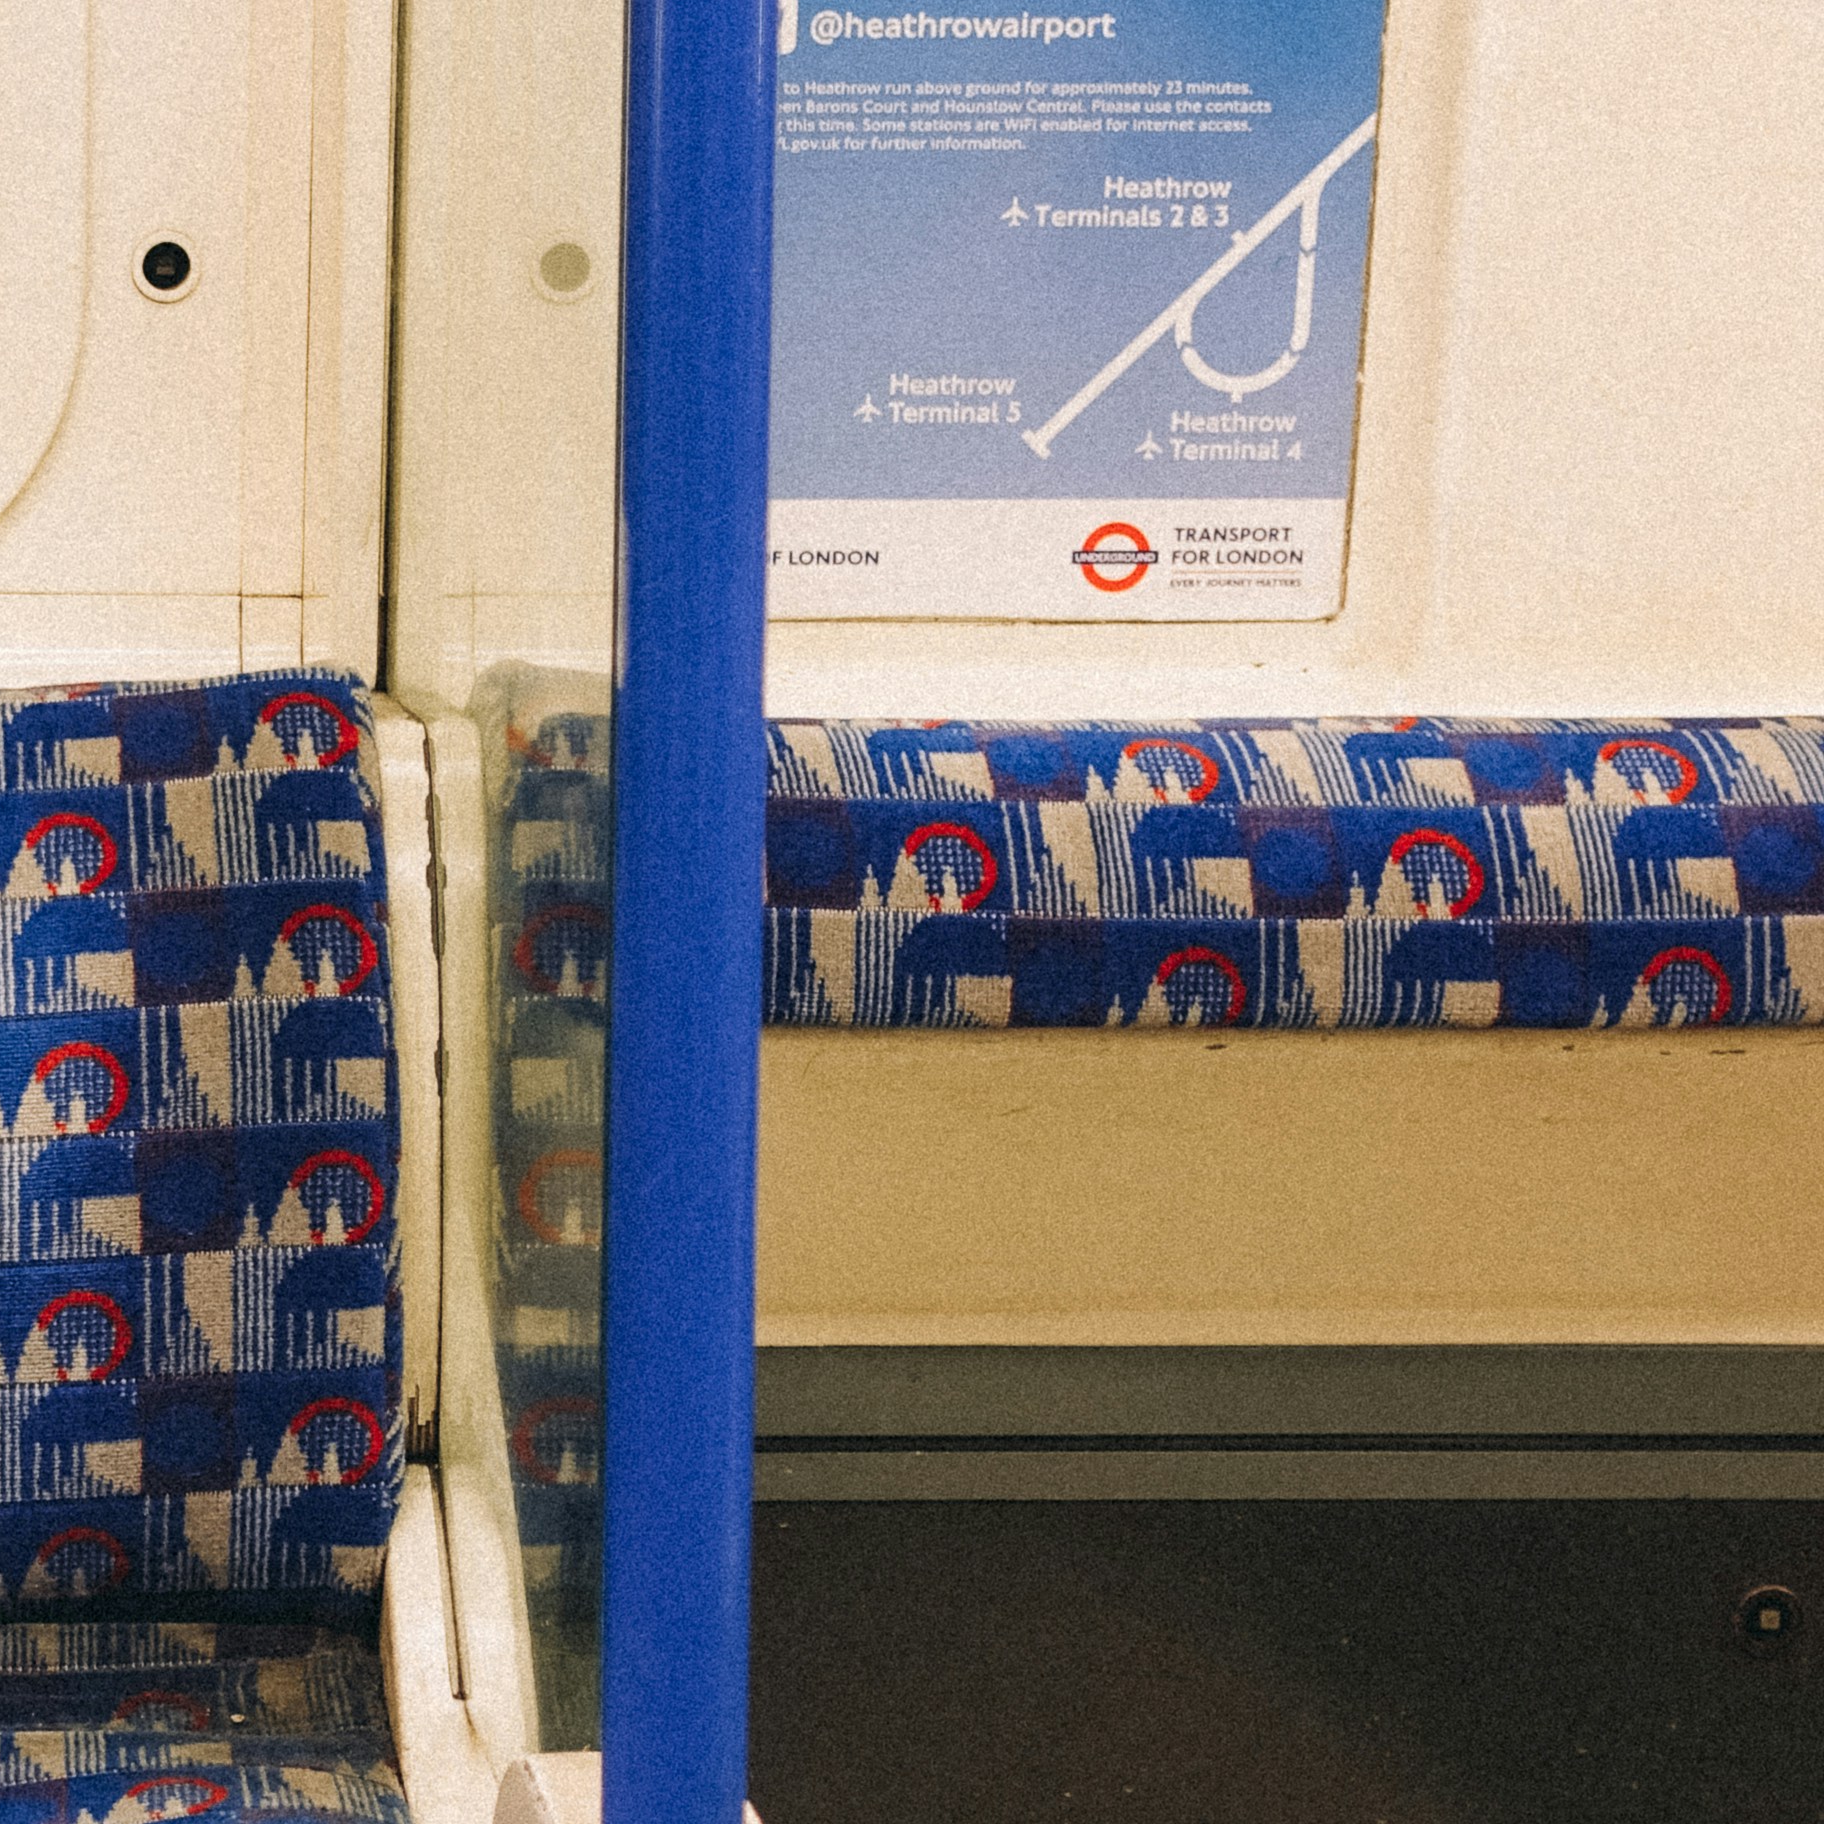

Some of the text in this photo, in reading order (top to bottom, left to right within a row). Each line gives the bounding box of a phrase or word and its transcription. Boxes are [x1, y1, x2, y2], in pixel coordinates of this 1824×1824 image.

[810, 10, 1115, 47] @heathrowairport
[1104, 176, 1232, 199] Heathrow
[1035, 203, 1229, 227] Terminals 2 & 3
[890, 374, 1016, 395] Heathrow
[889, 401, 1021, 423] Terminal 5
[1171, 410, 1297, 433] Heathrow
[1170, 438, 1303, 460] Terminal 4
[1175, 527, 1291, 542] TRANSPORT
[789, 550, 879, 566] LONDON
[1075, 552, 1157, 564] UNDERGROUND
[1172, 549, 1303, 565] FOR LONDON
